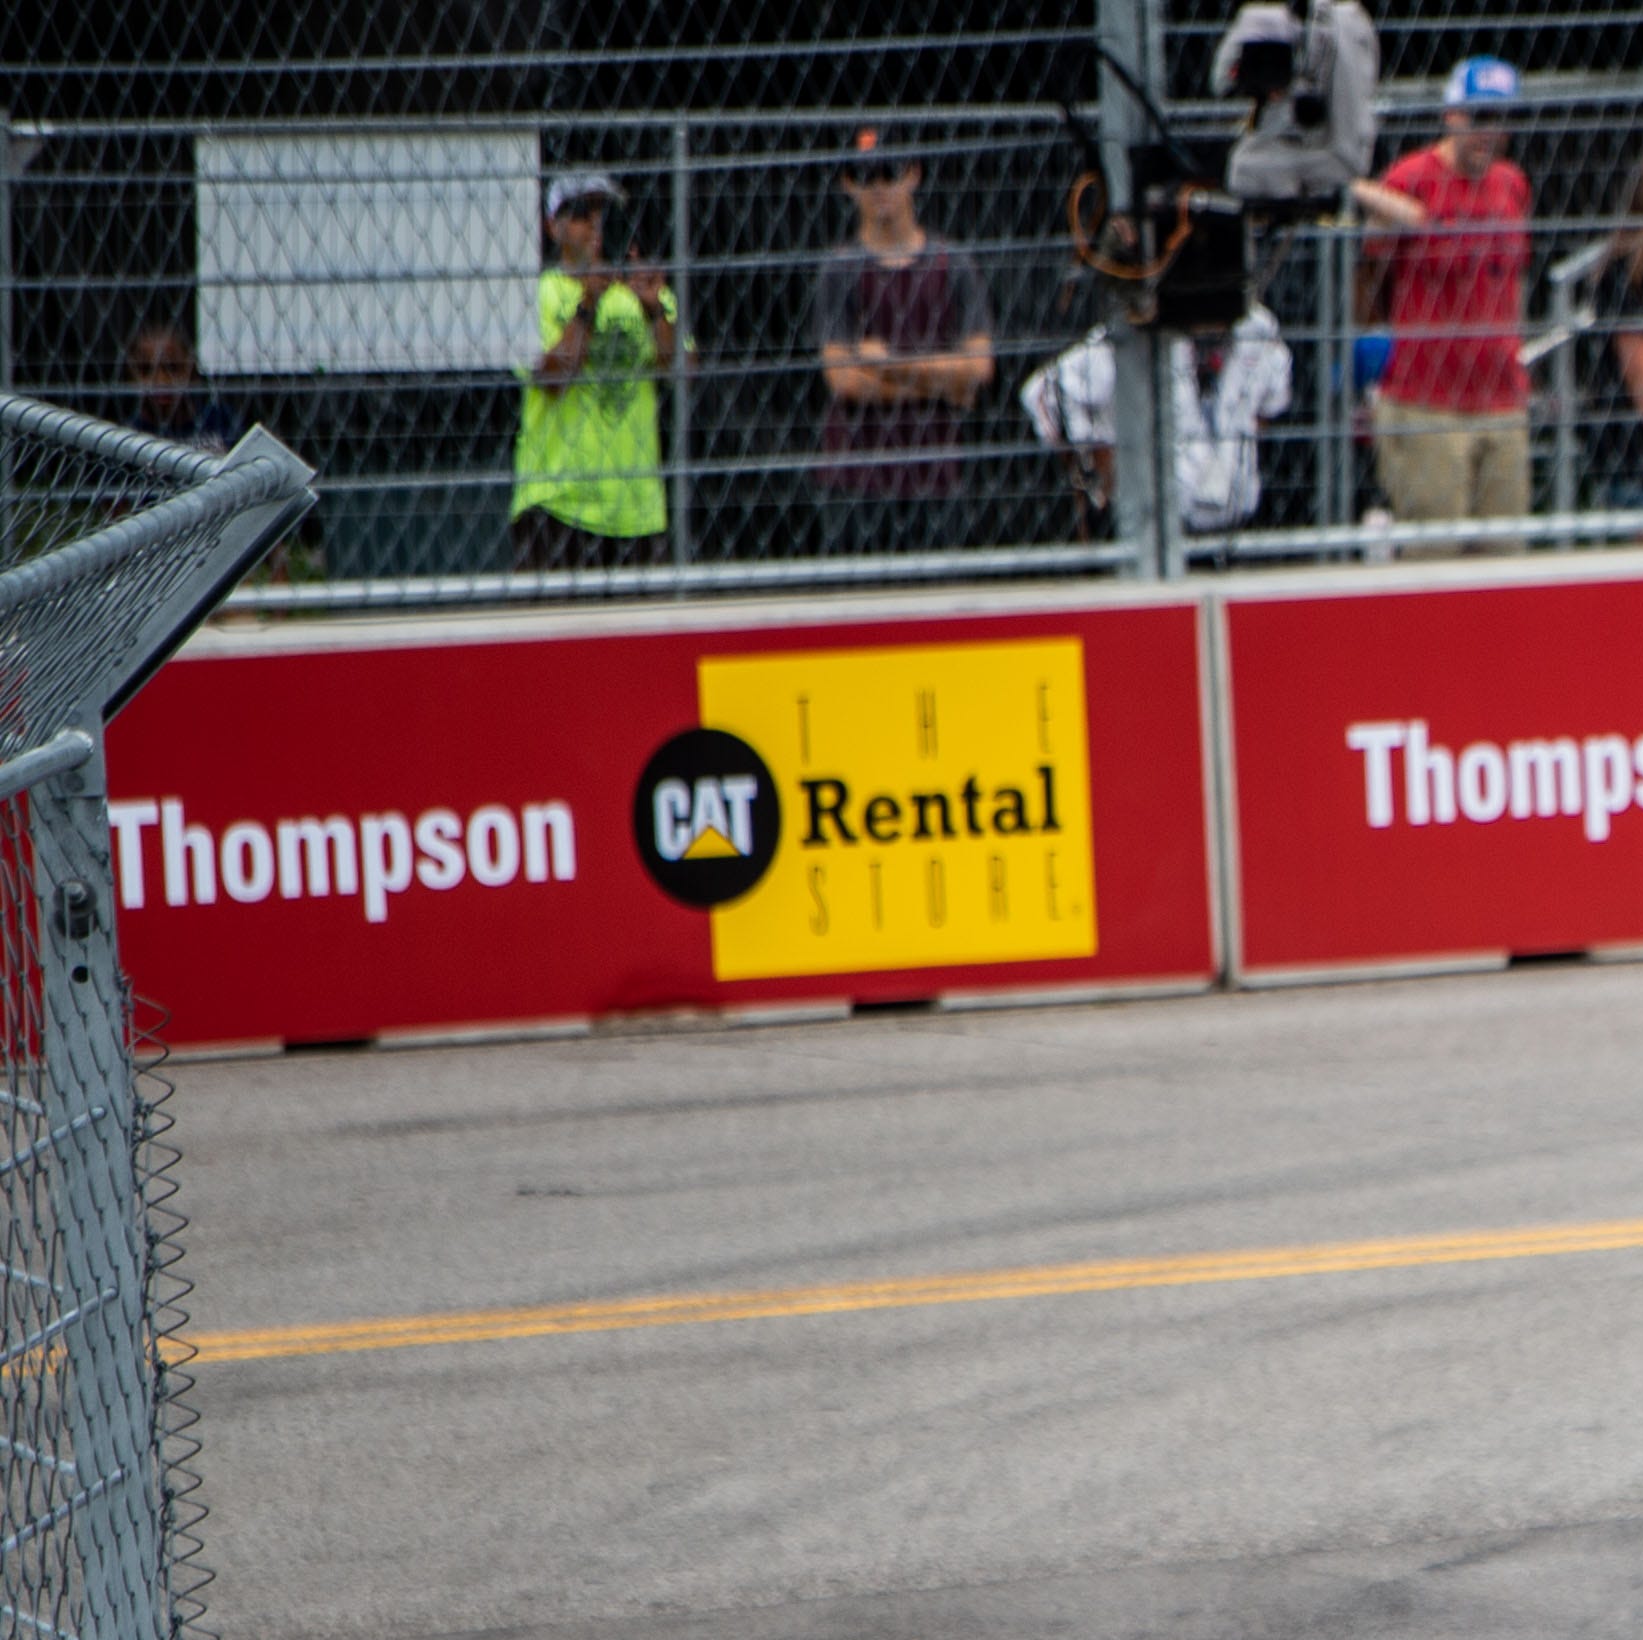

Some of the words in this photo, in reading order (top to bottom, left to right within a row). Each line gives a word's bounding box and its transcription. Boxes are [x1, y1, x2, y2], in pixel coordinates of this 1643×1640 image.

[652, 774, 758, 861] CAT
[798, 765, 1062, 848] Rental
[108, 794, 577, 923] Thompson
